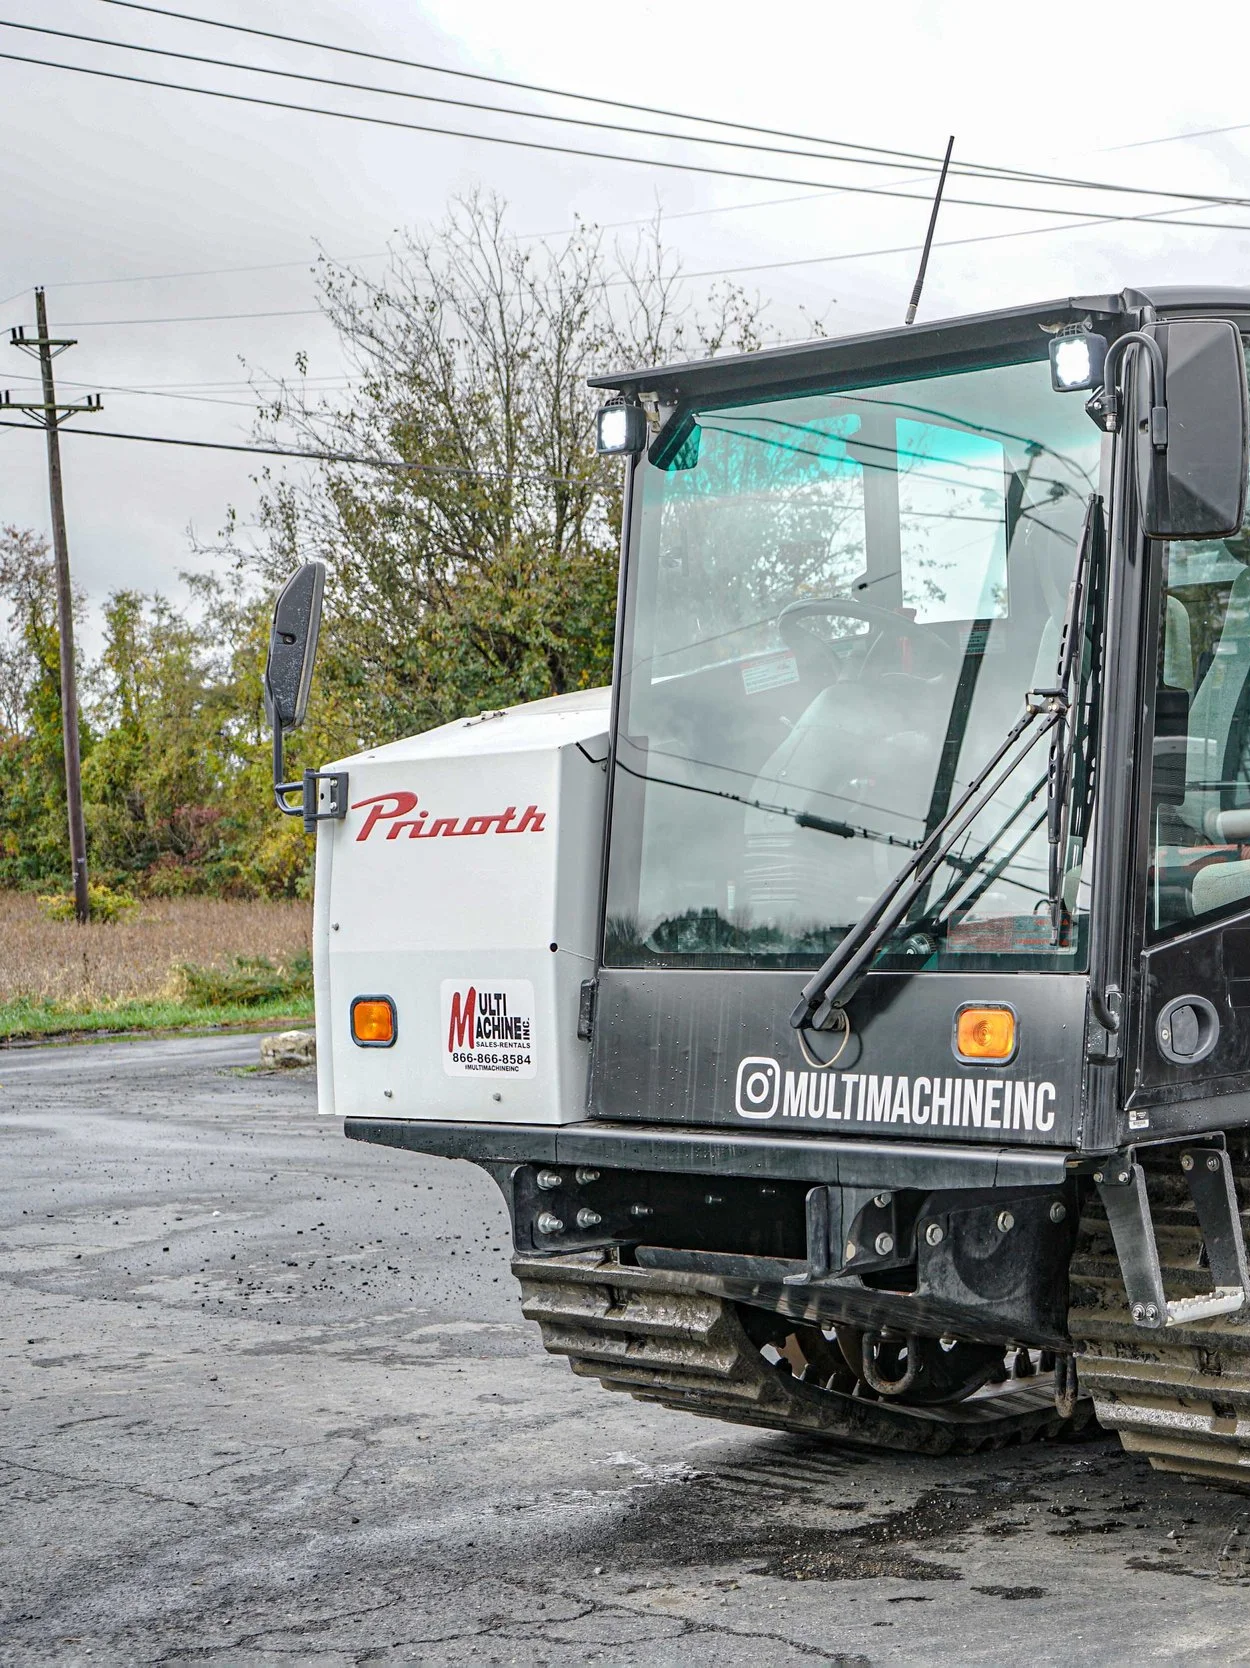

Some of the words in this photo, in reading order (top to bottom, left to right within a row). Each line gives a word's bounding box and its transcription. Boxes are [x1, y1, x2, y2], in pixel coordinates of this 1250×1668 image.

[351, 791, 546, 842] Prinoth
[452, 1053, 531, 1065] 866-866-8584
[782, 1071, 1056, 1132] MULTIMACHINEINC
